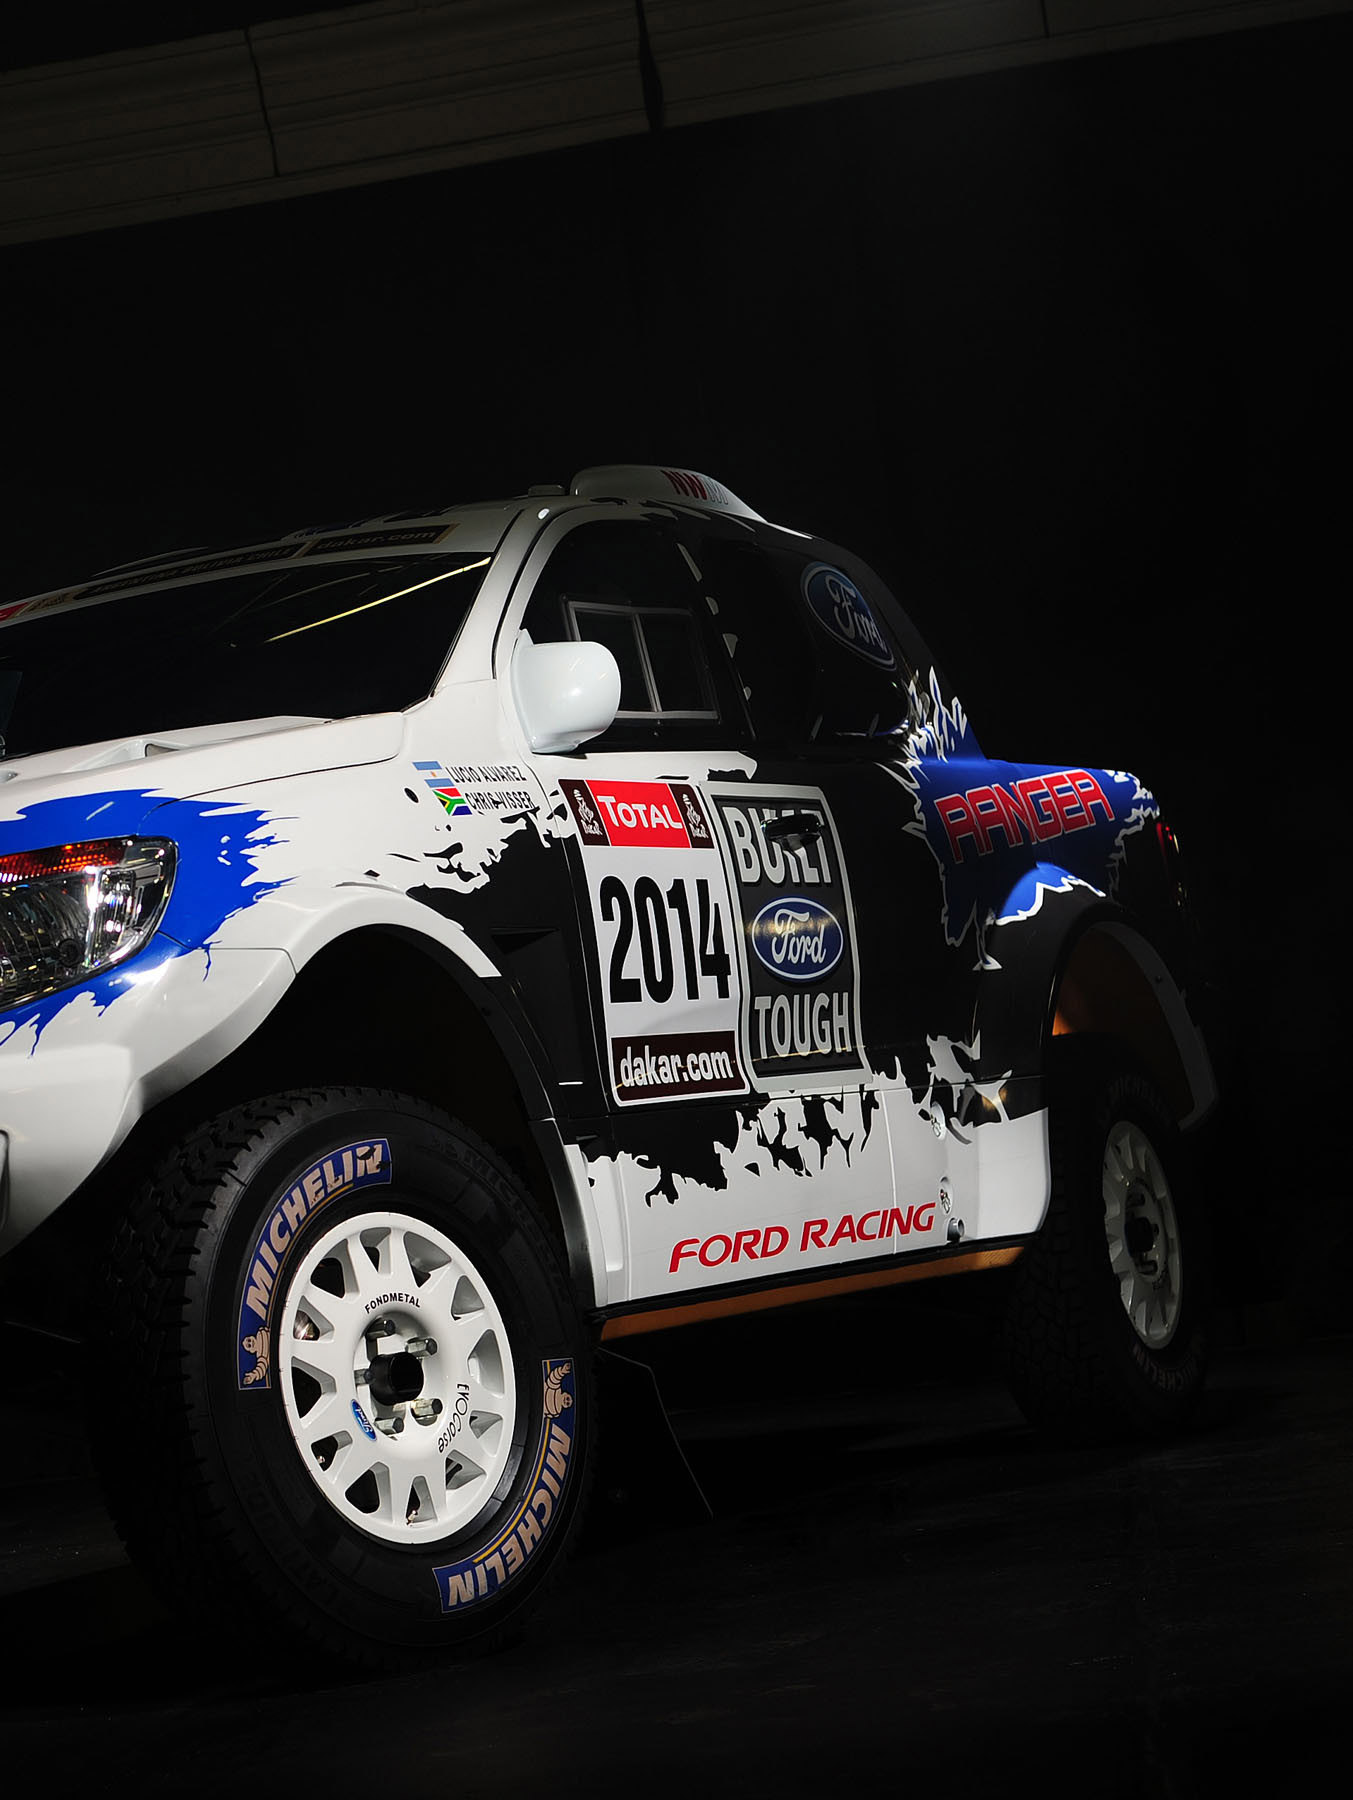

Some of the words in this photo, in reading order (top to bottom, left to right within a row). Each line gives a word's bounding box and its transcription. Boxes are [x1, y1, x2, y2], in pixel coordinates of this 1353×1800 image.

[824, 574, 889, 654] Ford
[445, 766, 482, 783] LUCIO
[477, 765, 527, 782] ALVAREZ
[464, 792, 499, 810] CHRIS
[494, 791, 536, 809] VISSER
[596, 795, 683, 829] TOTAL
[934, 768, 1116, 865] RANGER
[599, 875, 731, 1003] 2014
[770, 908, 826, 966] Ford
[754, 992, 853, 1060] TOUGH
[619, 1045, 734, 1088] dakar.com
[246, 1143, 384, 1321] MICHELIN
[668, 1226, 789, 1274] FORD
[799, 1202, 936, 1251] RACING
[364, 1292, 421, 1314] FONDMETAL
[448, 1423, 572, 1607] MICHELIN
